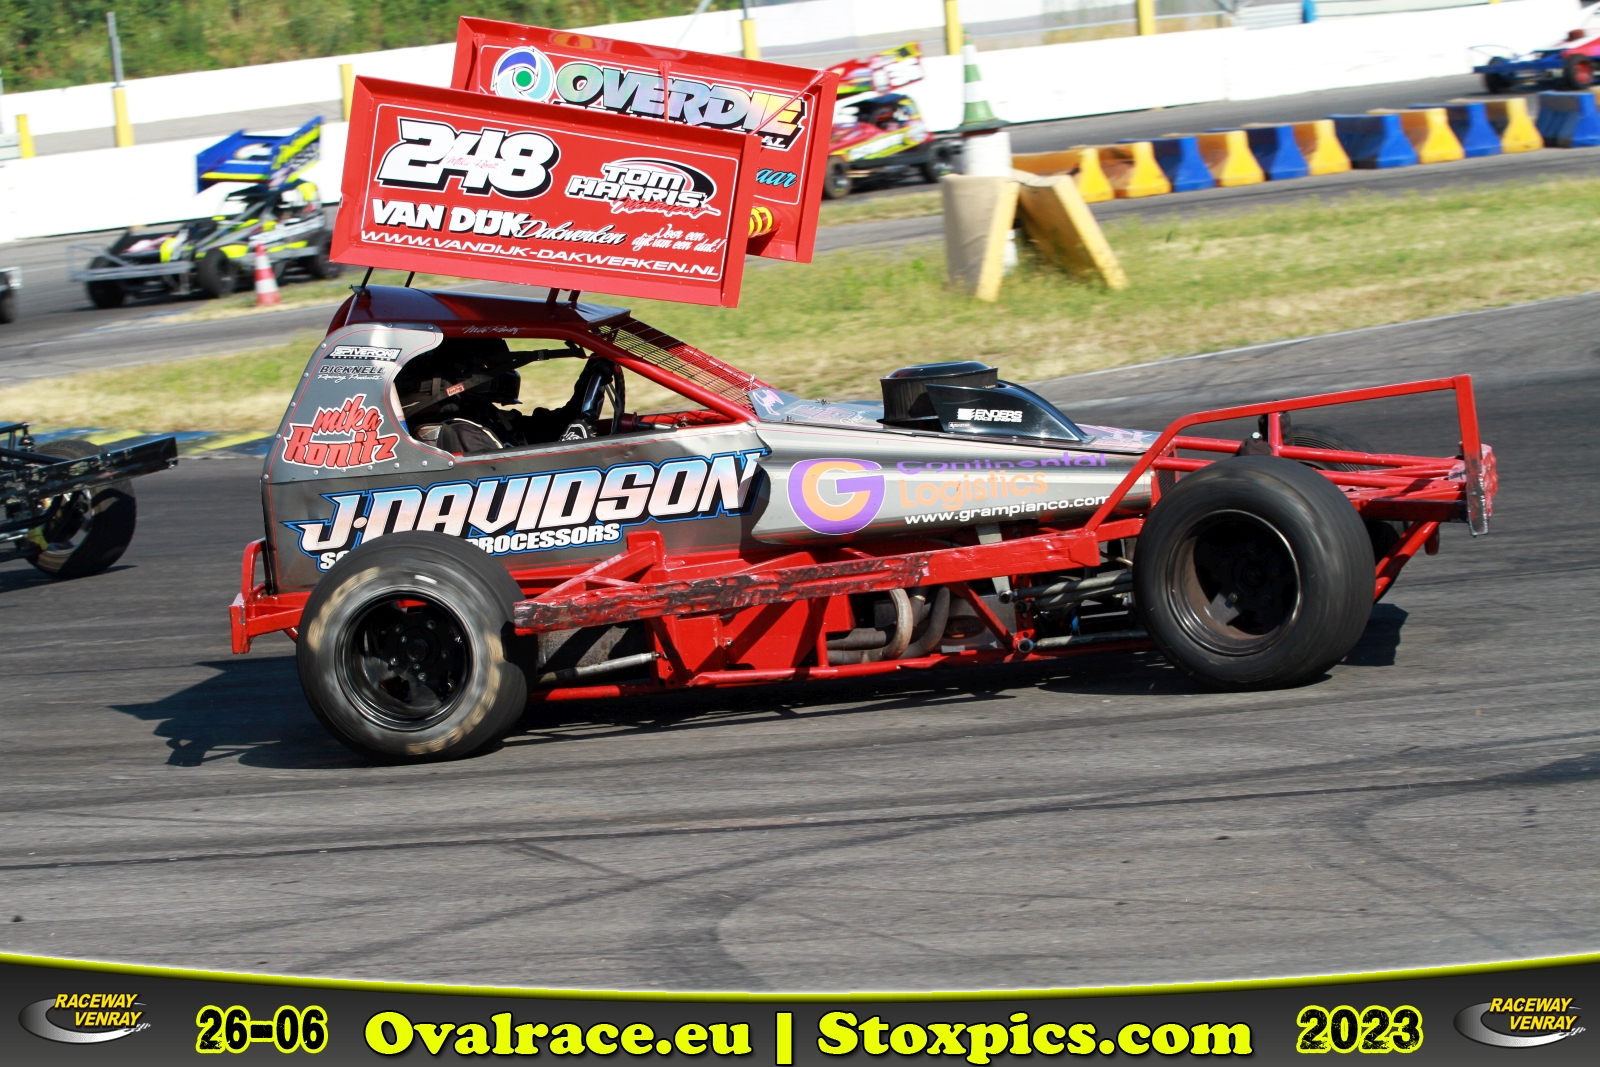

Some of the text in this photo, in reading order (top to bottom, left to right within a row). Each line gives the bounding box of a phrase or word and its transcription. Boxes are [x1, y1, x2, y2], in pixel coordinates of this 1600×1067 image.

[555, 62, 805, 137] OVERDIE
[376, 117, 560, 199] 248
[567, 176, 706, 208] HARRIS
[603, 164, 687, 192] TOM
[756, 168, 797, 188] aar
[372, 199, 627, 245] VAN DIJK Dakwerken
[685, 231, 706, 241] een
[361, 230, 719, 276] WWW.VANDIJK-DAKWERKEN.NL
[671, 240, 693, 250] een
[319, 365, 386, 375] BICKNELL
[974, 408, 1023, 419] ENDERS
[283, 423, 399, 468] Ronitz
[899, 470, 1048, 511] Logistics
